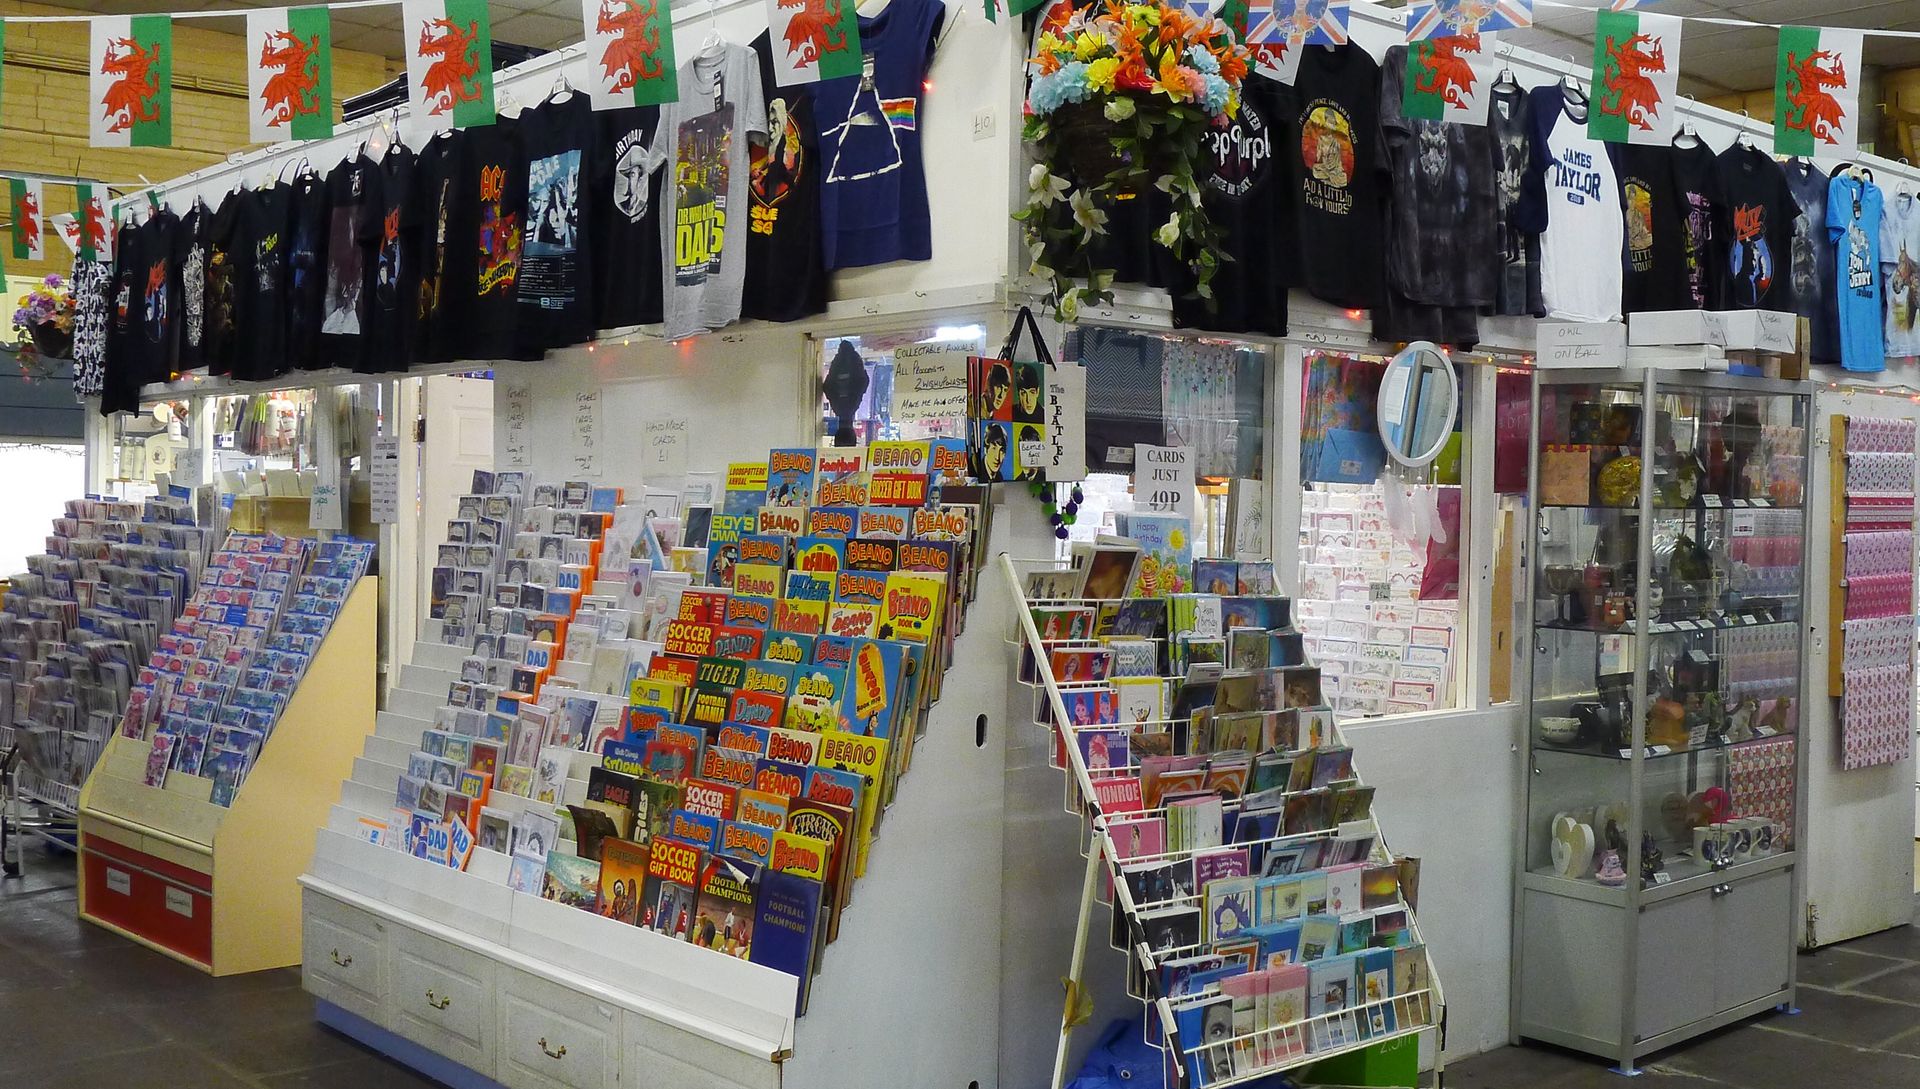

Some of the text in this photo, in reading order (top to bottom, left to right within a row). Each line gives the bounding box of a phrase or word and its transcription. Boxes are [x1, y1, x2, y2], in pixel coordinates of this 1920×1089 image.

[1563, 148, 1592, 169] JAMES
[1553, 157, 1602, 203] TAYLOR
[1558, 326, 1583, 337] OWL
[895, 345, 942, 359] COLLECTABLE
[1554, 345, 1602, 359] ON BALL
[896, 363, 909, 377] ALL
[1049, 394, 1064, 466] BEATLES
[771, 450, 813, 474] BEANO
[872, 447, 923, 467] BEANO
[933, 446, 968, 471] BEAN
[1147, 449, 1185, 463] CARDS
[1151, 468, 1180, 482] JUST
[821, 482, 867, 506] BEANO
[1149, 490, 1181, 511] 49P
[711, 515, 755, 531] BOY'S
[760, 511, 800, 533] BEANO
[811, 510, 852, 534] BEANO
[860, 511, 904, 535] BEANO
[915, 509, 966, 536] BEANO
[1136, 521, 1159, 532] Happy
[711, 530, 739, 542] OWN
[740, 538, 780, 562] BEANO
[848, 540, 893, 566] BEANO
[900, 543, 949, 570] BEANO
[559, 572, 579, 589] DAD
[737, 574, 775, 595] BEANO
[838, 572, 885, 600] BEANO
[681, 595, 703, 607] SOCCER
[728, 598, 769, 623] BEANO
[789, 603, 799, 611] THE
[888, 588, 932, 620] BEANO
[668, 622, 712, 644] SOCCER
[666, 640, 710, 655] GIFT BOOK
[715, 634, 756, 658] DANDY
[767, 640, 803, 663] BEANO
[817, 639, 850, 663] BEAN
[526, 649, 548, 668] DAD
[699, 663, 740, 686] TIGER
[744, 666, 788, 695] BEANO
[858, 652, 881, 699] BEANO
[797, 675, 835, 700] BEANO
[697, 693, 727, 708] FOOTBALL
[735, 697, 774, 723] DANDY
[694, 703, 726, 724] MANIA
[768, 732, 813, 765] BEANO
[824, 739, 877, 767] BEANO
[703, 749, 755, 785] BEANO
[756, 769, 802, 798] BEANO
[684, 801, 700, 814] GIFT
[685, 785, 724, 809] SOCCER
[743, 801, 783, 831] BEANO
[428, 828, 448, 851] DAD
[673, 815, 712, 843] BEANO
[724, 824, 770, 857] BEANO
[650, 841, 697, 871] SOCCER
[773, 838, 820, 873] BEANO
[649, 860, 695, 885] GIFT BOOK
[704, 884, 753, 905] CHAMPIONS
[768, 900, 805, 918] FOOTBALL
[763, 912, 806, 932] CHAMPIONS
